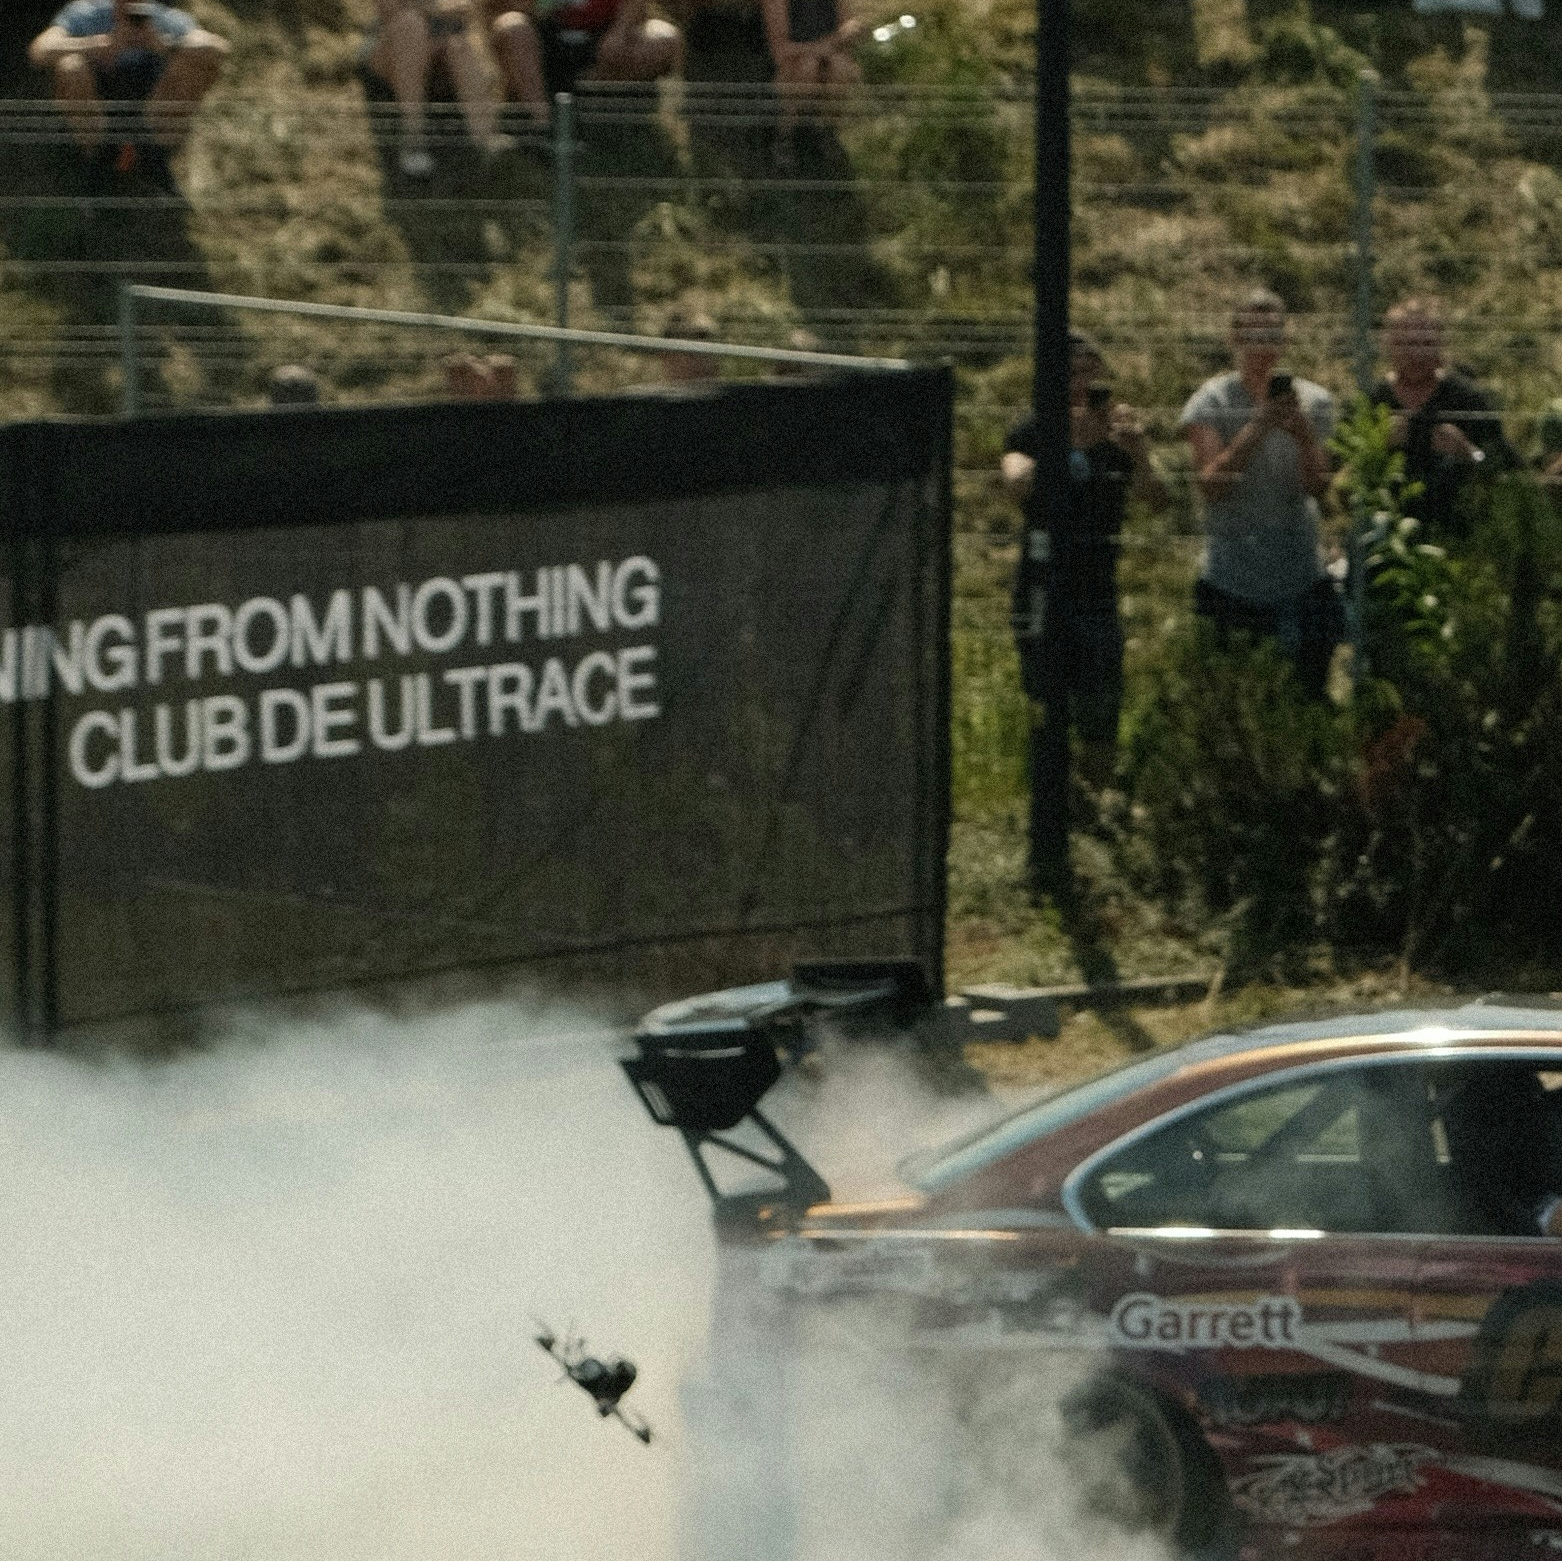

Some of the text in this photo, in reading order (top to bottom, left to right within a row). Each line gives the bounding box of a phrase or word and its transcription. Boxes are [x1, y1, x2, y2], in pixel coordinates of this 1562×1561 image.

[144, 588, 353, 686] FROM
[361, 554, 661, 661] NOTHING
[68, 644, 662, 789] CLUB DE ULTRACE
[1116, 1295, 1300, 1343] Garrett
